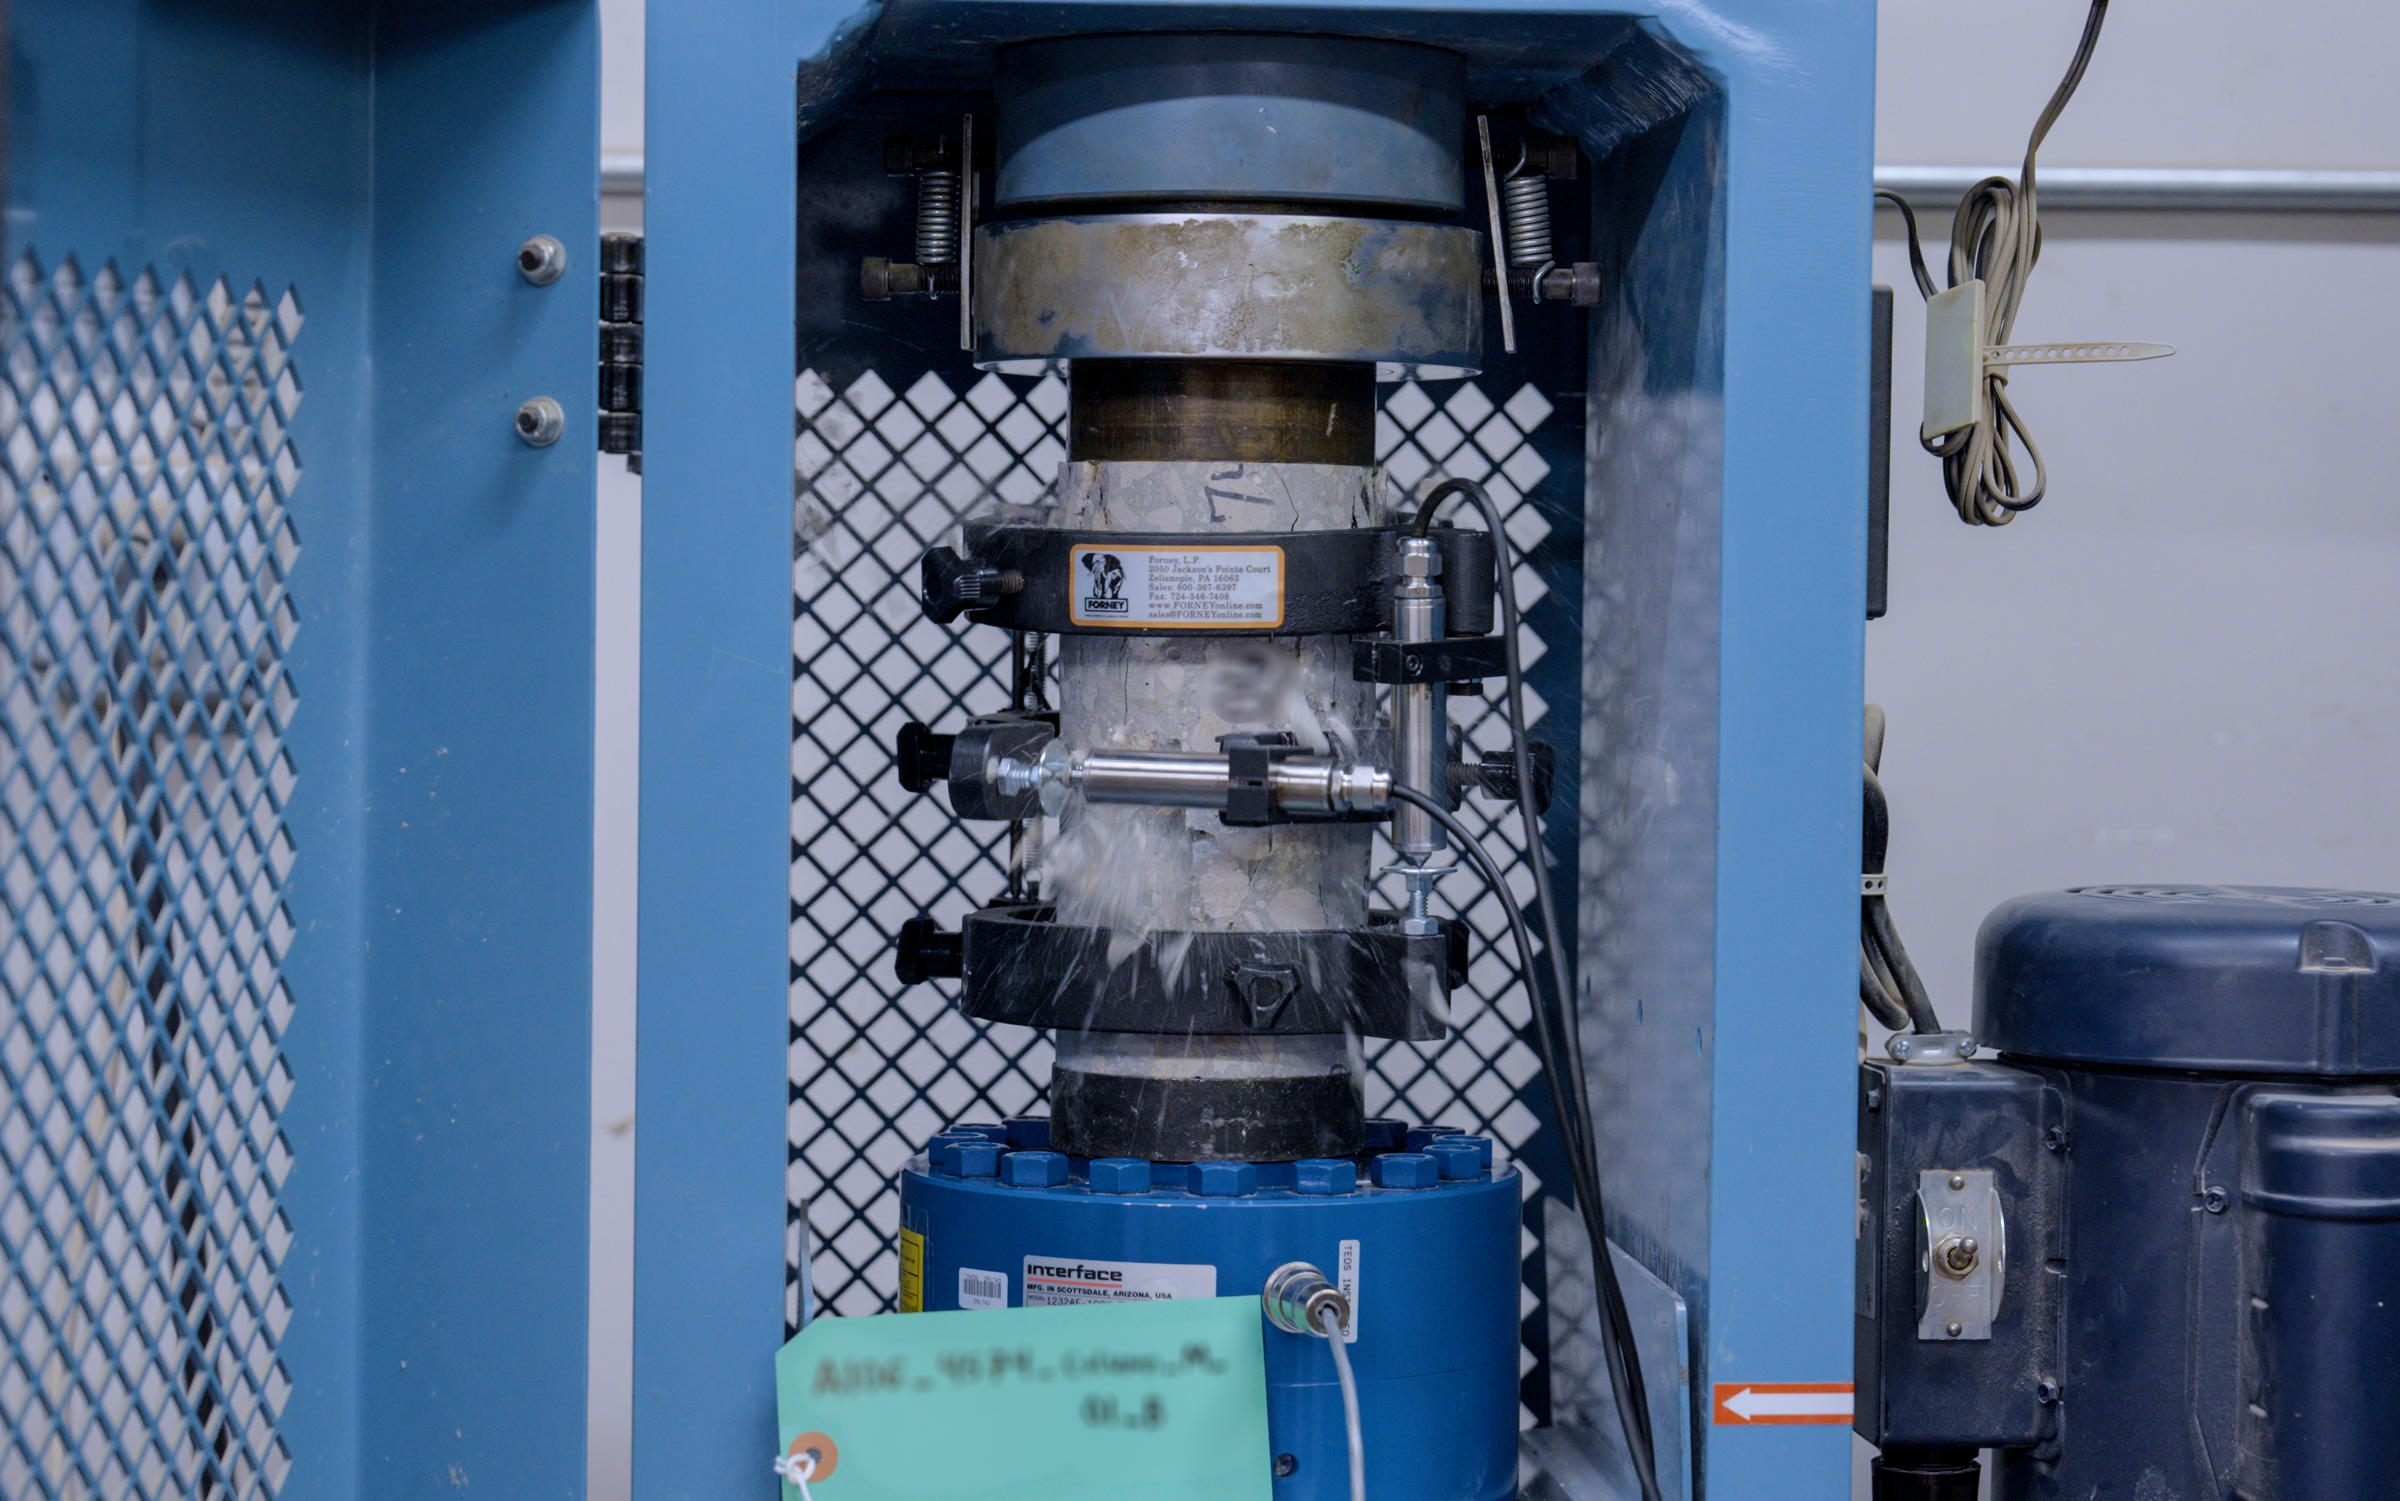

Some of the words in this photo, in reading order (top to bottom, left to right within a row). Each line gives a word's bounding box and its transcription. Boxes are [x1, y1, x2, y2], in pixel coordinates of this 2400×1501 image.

[1149, 555, 1181, 566] Forney,
[1149, 564, 1170, 573] 2050
[1172, 564, 1213, 573] Jackson's
[1215, 564, 1244, 573] Pointe
[1246, 564, 1271, 573] Court
[1149, 574, 1195, 584] Zelienople,
[1199, 574, 1210, 582] PA
[1214, 574, 1240, 582] 16063
[1088, 600, 1125, 609] FORNEY
[1149, 601, 1263, 610] www.FORNEYonline.com
[1149, 610, 1262, 619] sales@FORNEYonline.com
[1940, 1207, 1978, 1230] ON
[1343, 1244, 1352, 1272] TEDS
[1027, 1283, 1045, 1292] MFG.
[1046, 1284, 1055, 1292] IN
[1056, 1286, 1111, 1298] SCOTTSDALE,
[1113, 1290, 1152, 1300] ARIZONA,
[1155, 1292, 1172, 1300] USA
